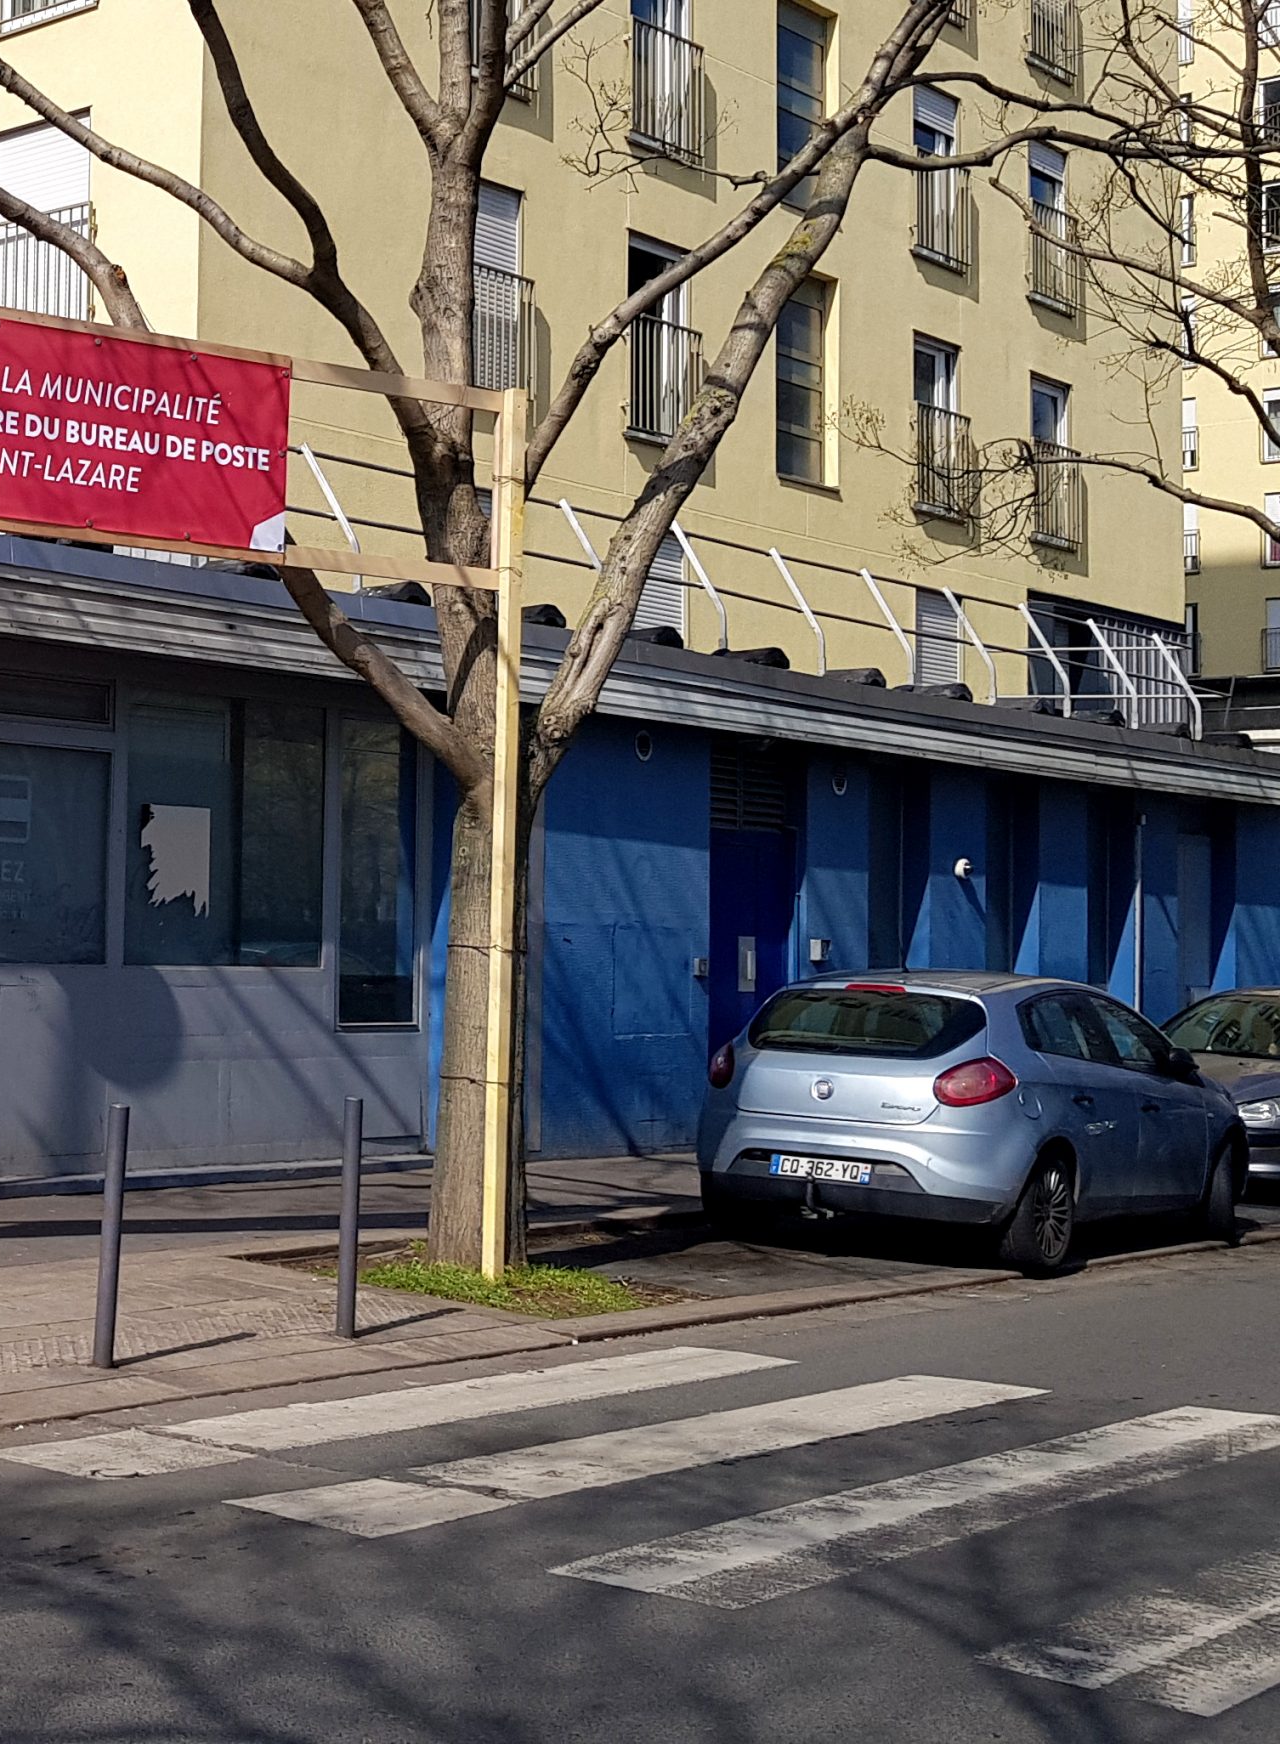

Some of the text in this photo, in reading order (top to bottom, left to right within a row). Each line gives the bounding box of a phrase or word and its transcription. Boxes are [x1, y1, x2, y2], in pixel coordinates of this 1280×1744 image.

[1, 366, 32, 396] LA
[40, 372, 222, 425] MUNICIPALITÉ
[24, 413, 60, 441] DU
[66, 419, 160, 455] BUREAU
[166, 434, 196, 461] DE
[201, 440, 270, 471] POSTE
[780, 1157, 861, 1181] CQ-362-YQ
